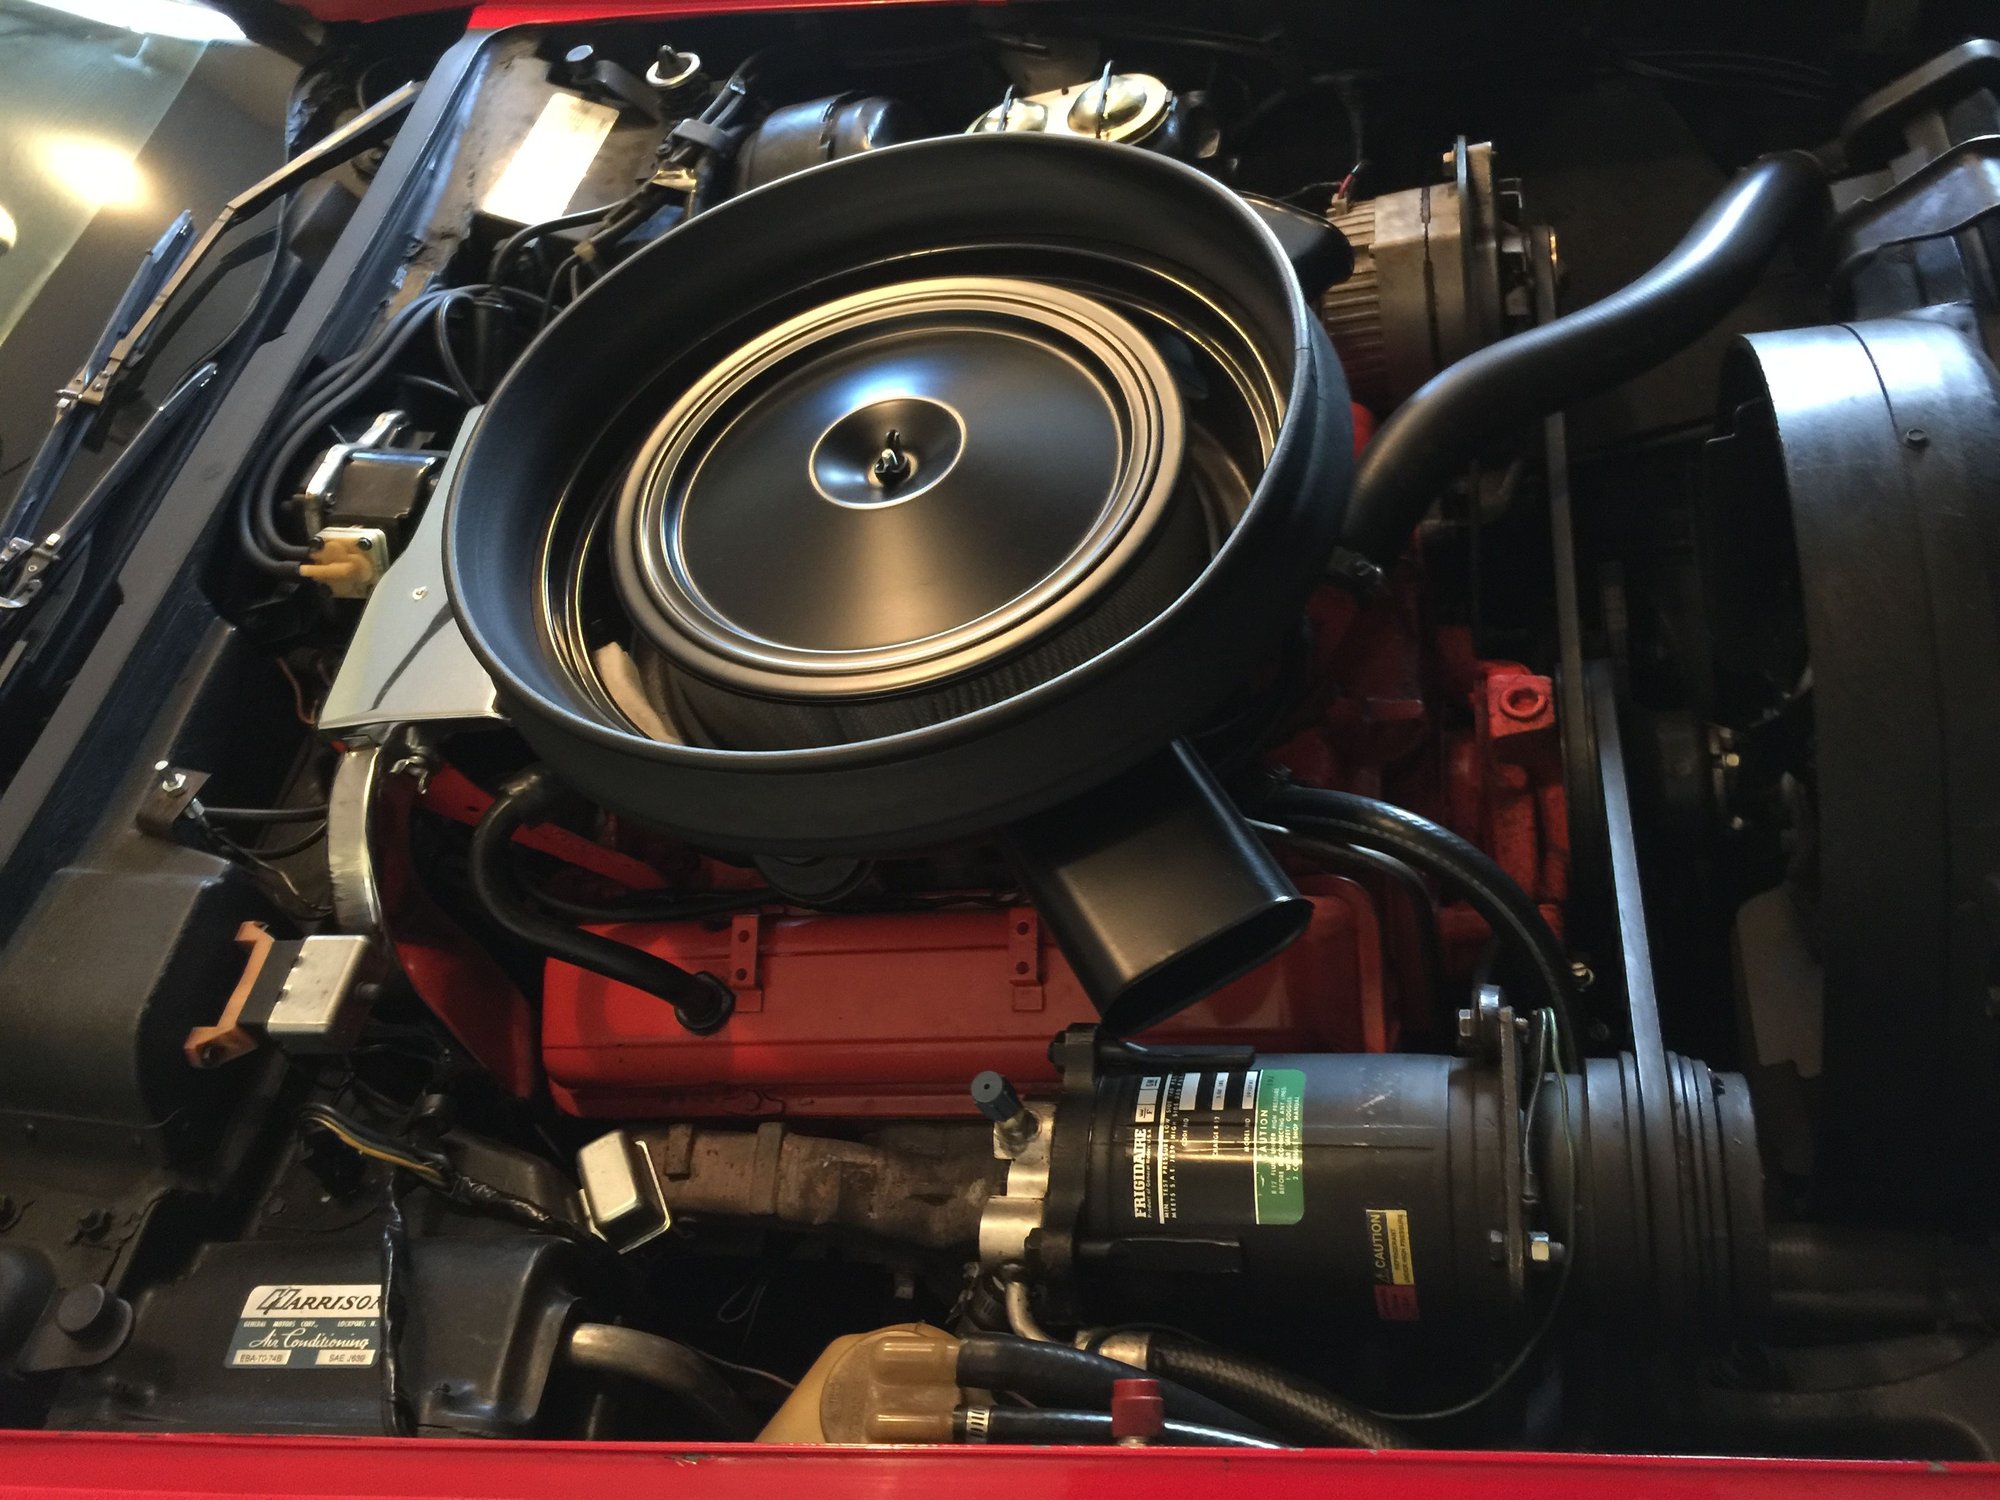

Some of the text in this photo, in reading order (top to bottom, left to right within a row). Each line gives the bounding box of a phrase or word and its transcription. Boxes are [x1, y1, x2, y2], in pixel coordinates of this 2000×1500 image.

[1133, 1128, 1147, 1218] FRIGIDAIRE
[1169, 1192, 1177, 1218] MEETS
[1370, 1213, 1386, 1268] CAUTION
[272, 1320, 296, 1328] MOTORS
[248, 1327, 370, 1350] Air Conditioning
[328, 1353, 346, 1363] SAE
